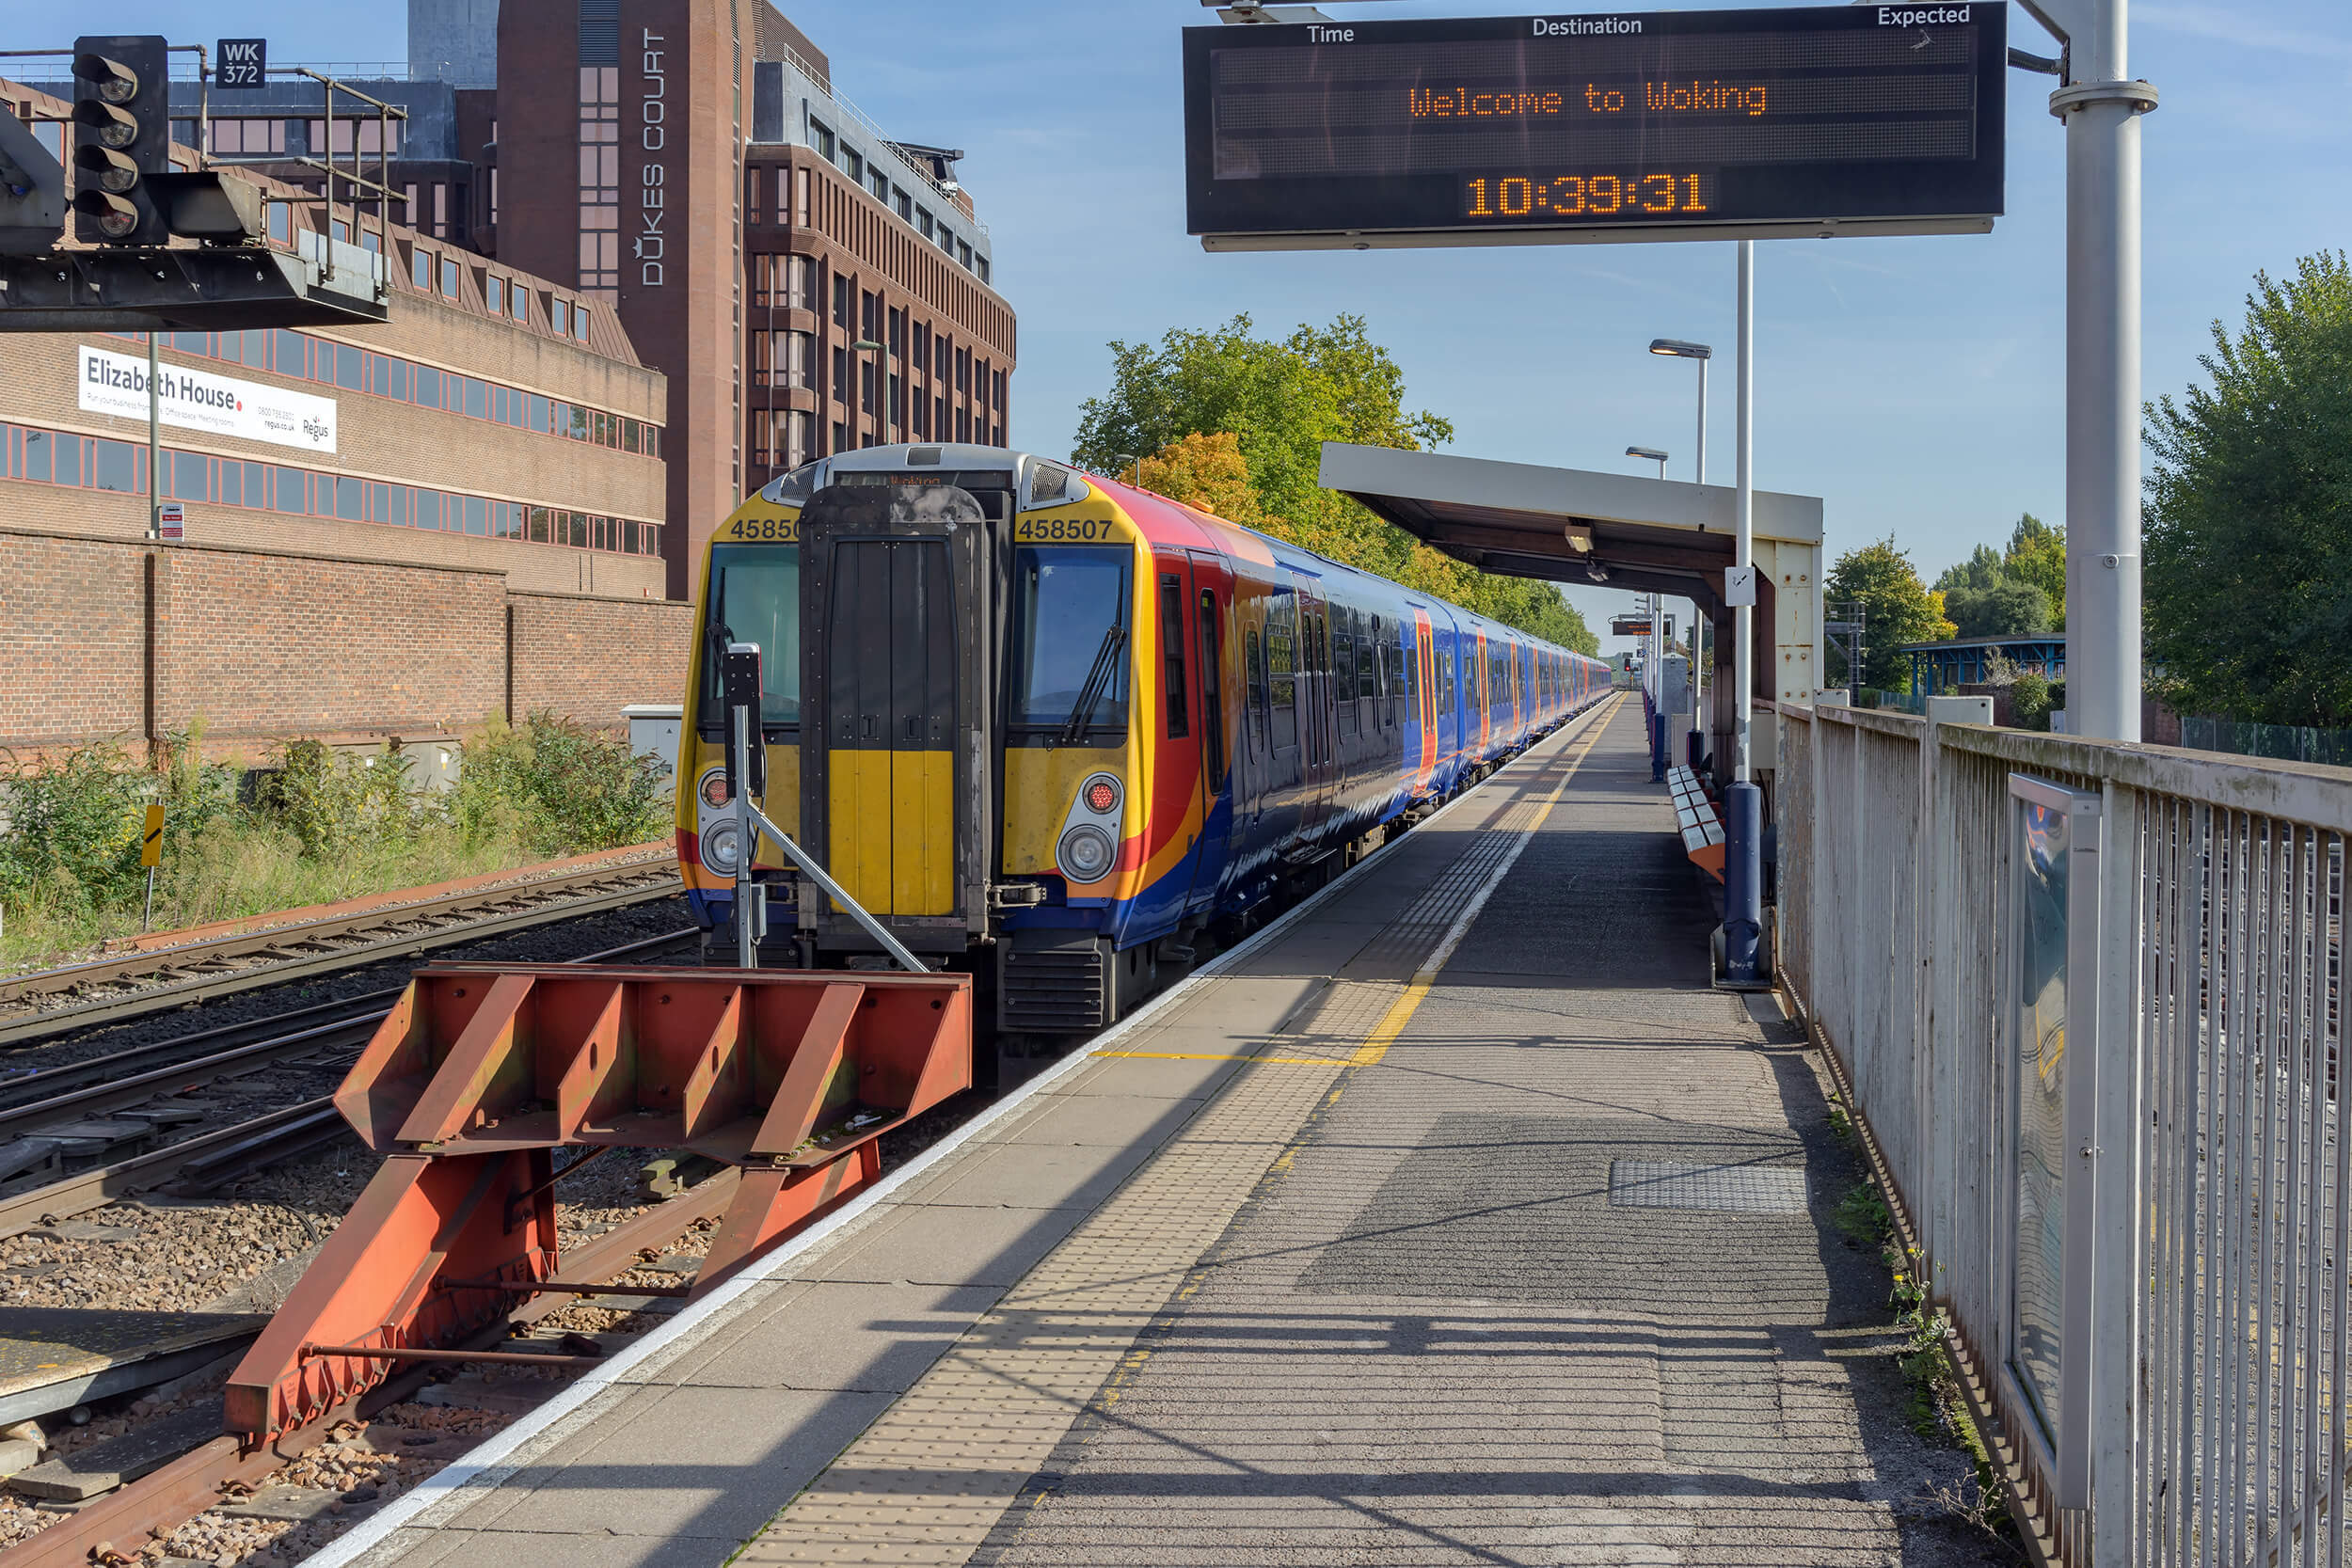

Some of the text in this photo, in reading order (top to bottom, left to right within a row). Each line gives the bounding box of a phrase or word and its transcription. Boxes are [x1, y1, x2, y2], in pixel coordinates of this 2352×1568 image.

[1307, 5, 1971, 43] Time Destination Expected
[224, 43, 260, 61] WK
[224, 65, 258, 84] 372
[1409, 79, 1768, 118] Welcome to Woking
[642, 27, 665, 286] DUKES COURT
[1468, 173, 1708, 216] 10:39:31
[303, 419, 329, 442] Regus
[1018, 518, 1113, 540] 458507
